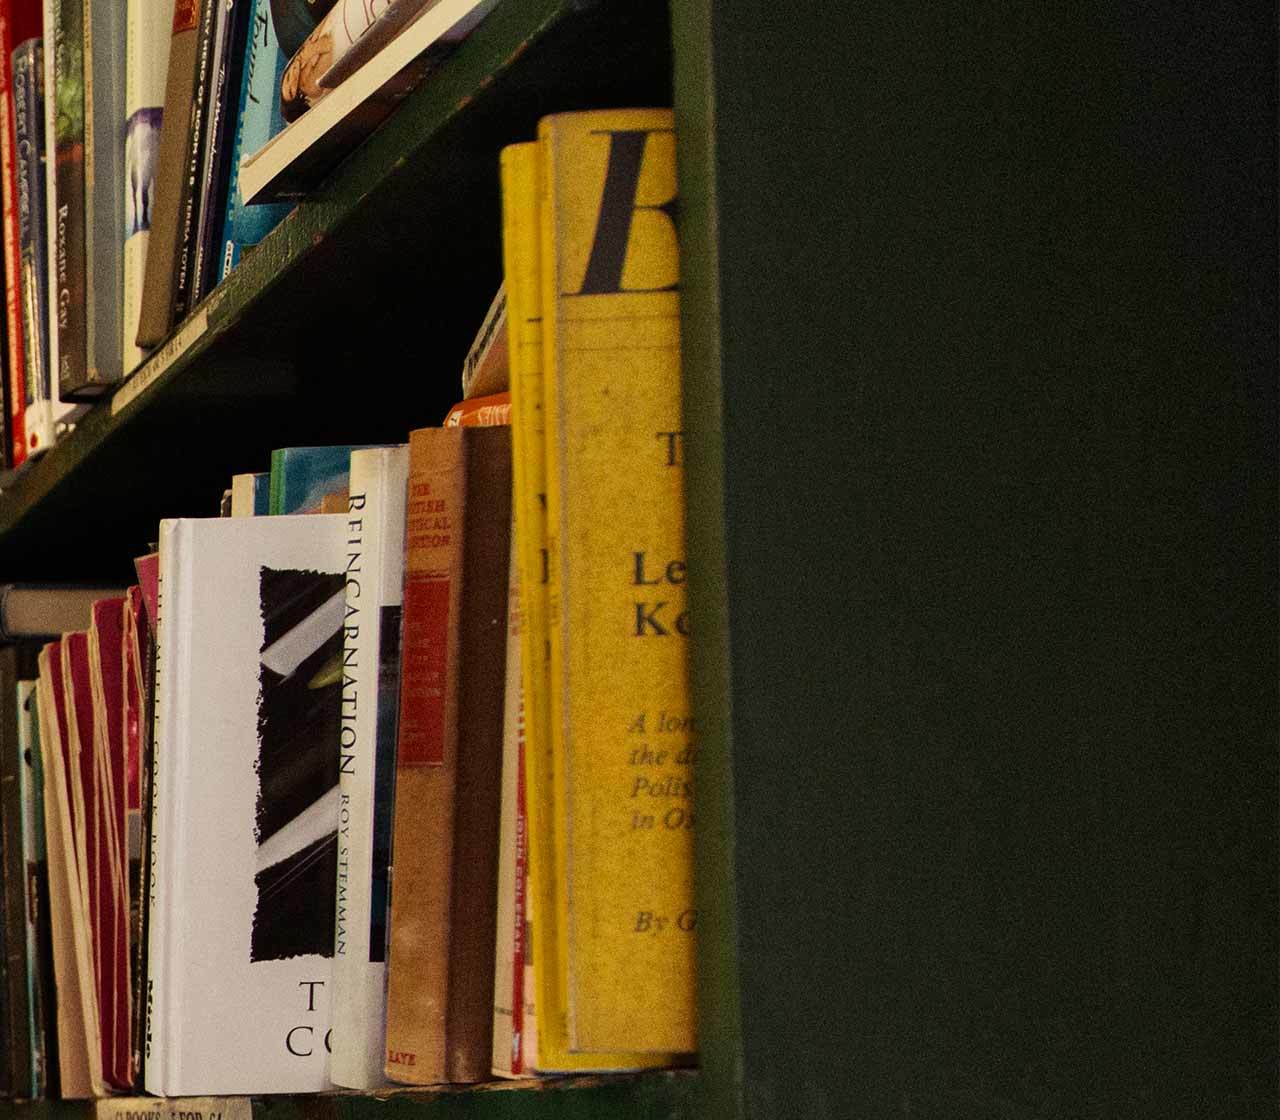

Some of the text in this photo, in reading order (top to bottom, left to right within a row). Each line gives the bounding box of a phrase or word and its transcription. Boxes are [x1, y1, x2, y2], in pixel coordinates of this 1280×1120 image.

[198, 40, 210, 76] HERO
[248, 9, 269, 105] Found
[196, 79, 206, 103] OF
[191, 110, 203, 154] ROOM
[181, 198, 195, 243] TERESA
[56, 203, 70, 330] Roxane Gay
[177, 247, 189, 289] TOTEN
[633, 551, 688, 586] Le
[337, 492, 367, 956] REINCARNATION ROY STEMMAN
[657, 710, 695, 733] lon
[630, 776, 694, 800] Polis
